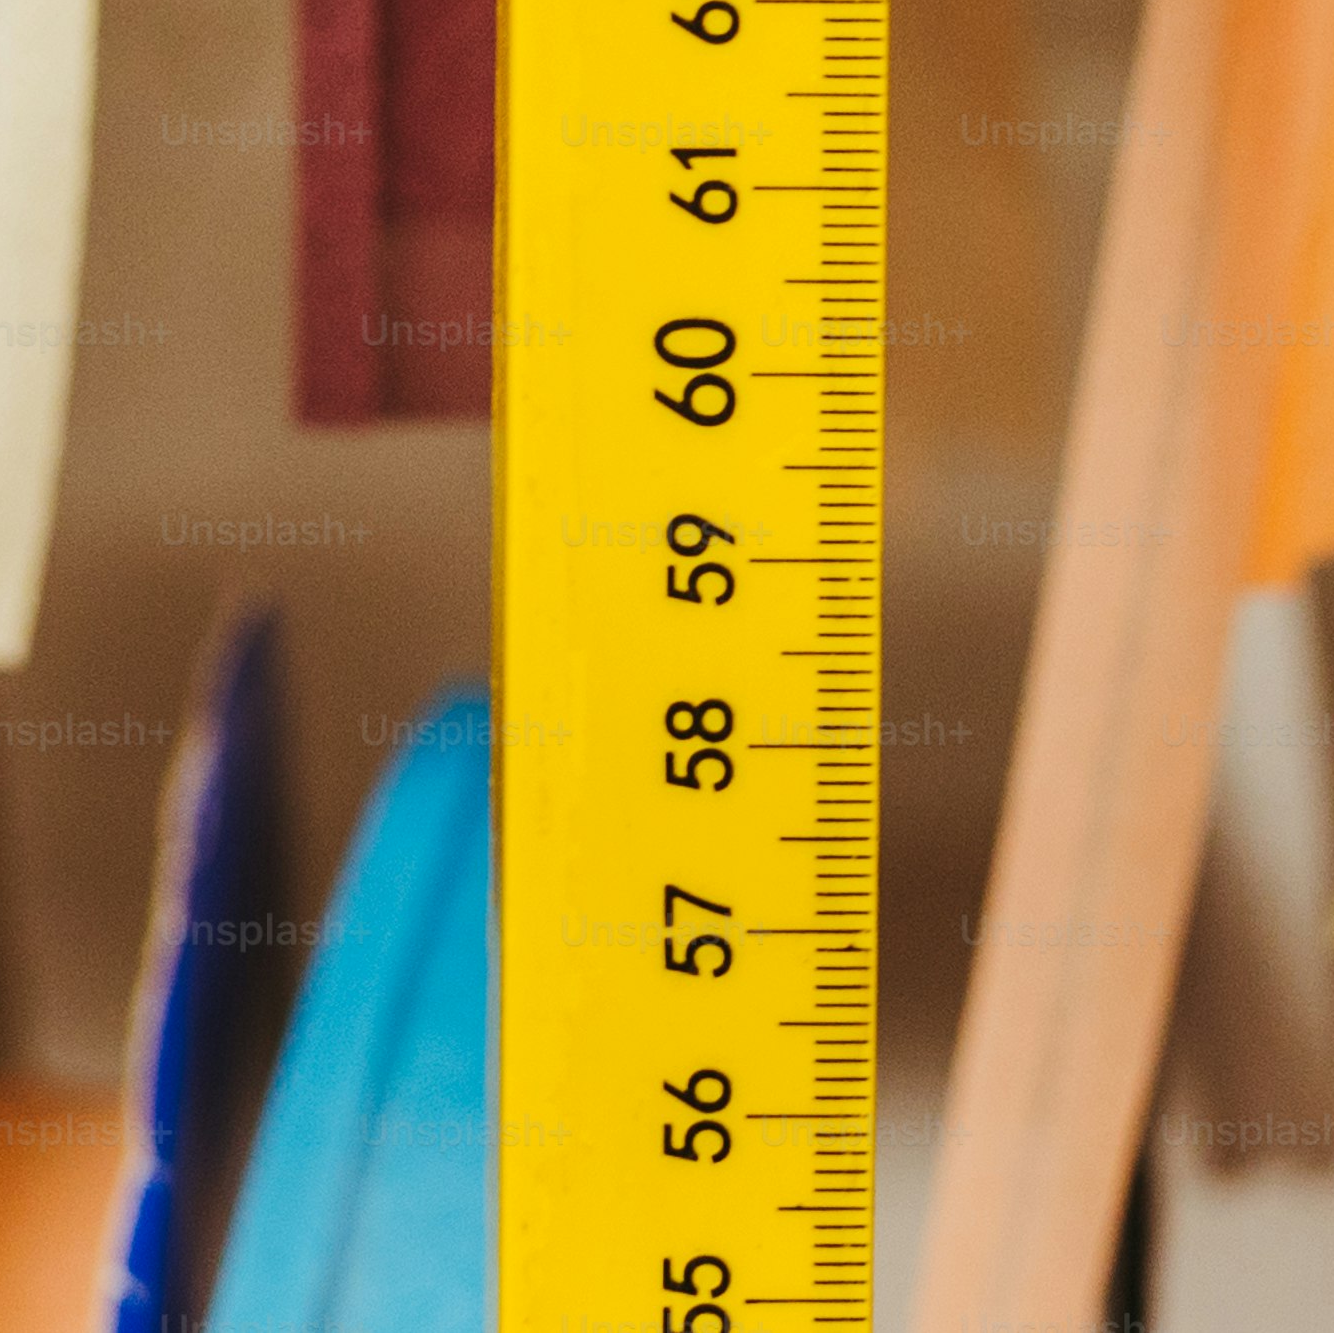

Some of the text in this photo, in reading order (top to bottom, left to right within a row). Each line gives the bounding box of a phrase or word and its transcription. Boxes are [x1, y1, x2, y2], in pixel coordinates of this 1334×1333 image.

[669, 147, 738, 225] 61
[653, 318, 737, 427] 60
[666, 513, 736, 606] 59
[664, 698, 735, 792] 58
[663, 884, 733, 978] 57
[662, 1068, 732, 1164] 56
[662, 1254, 732, 1333] 55
